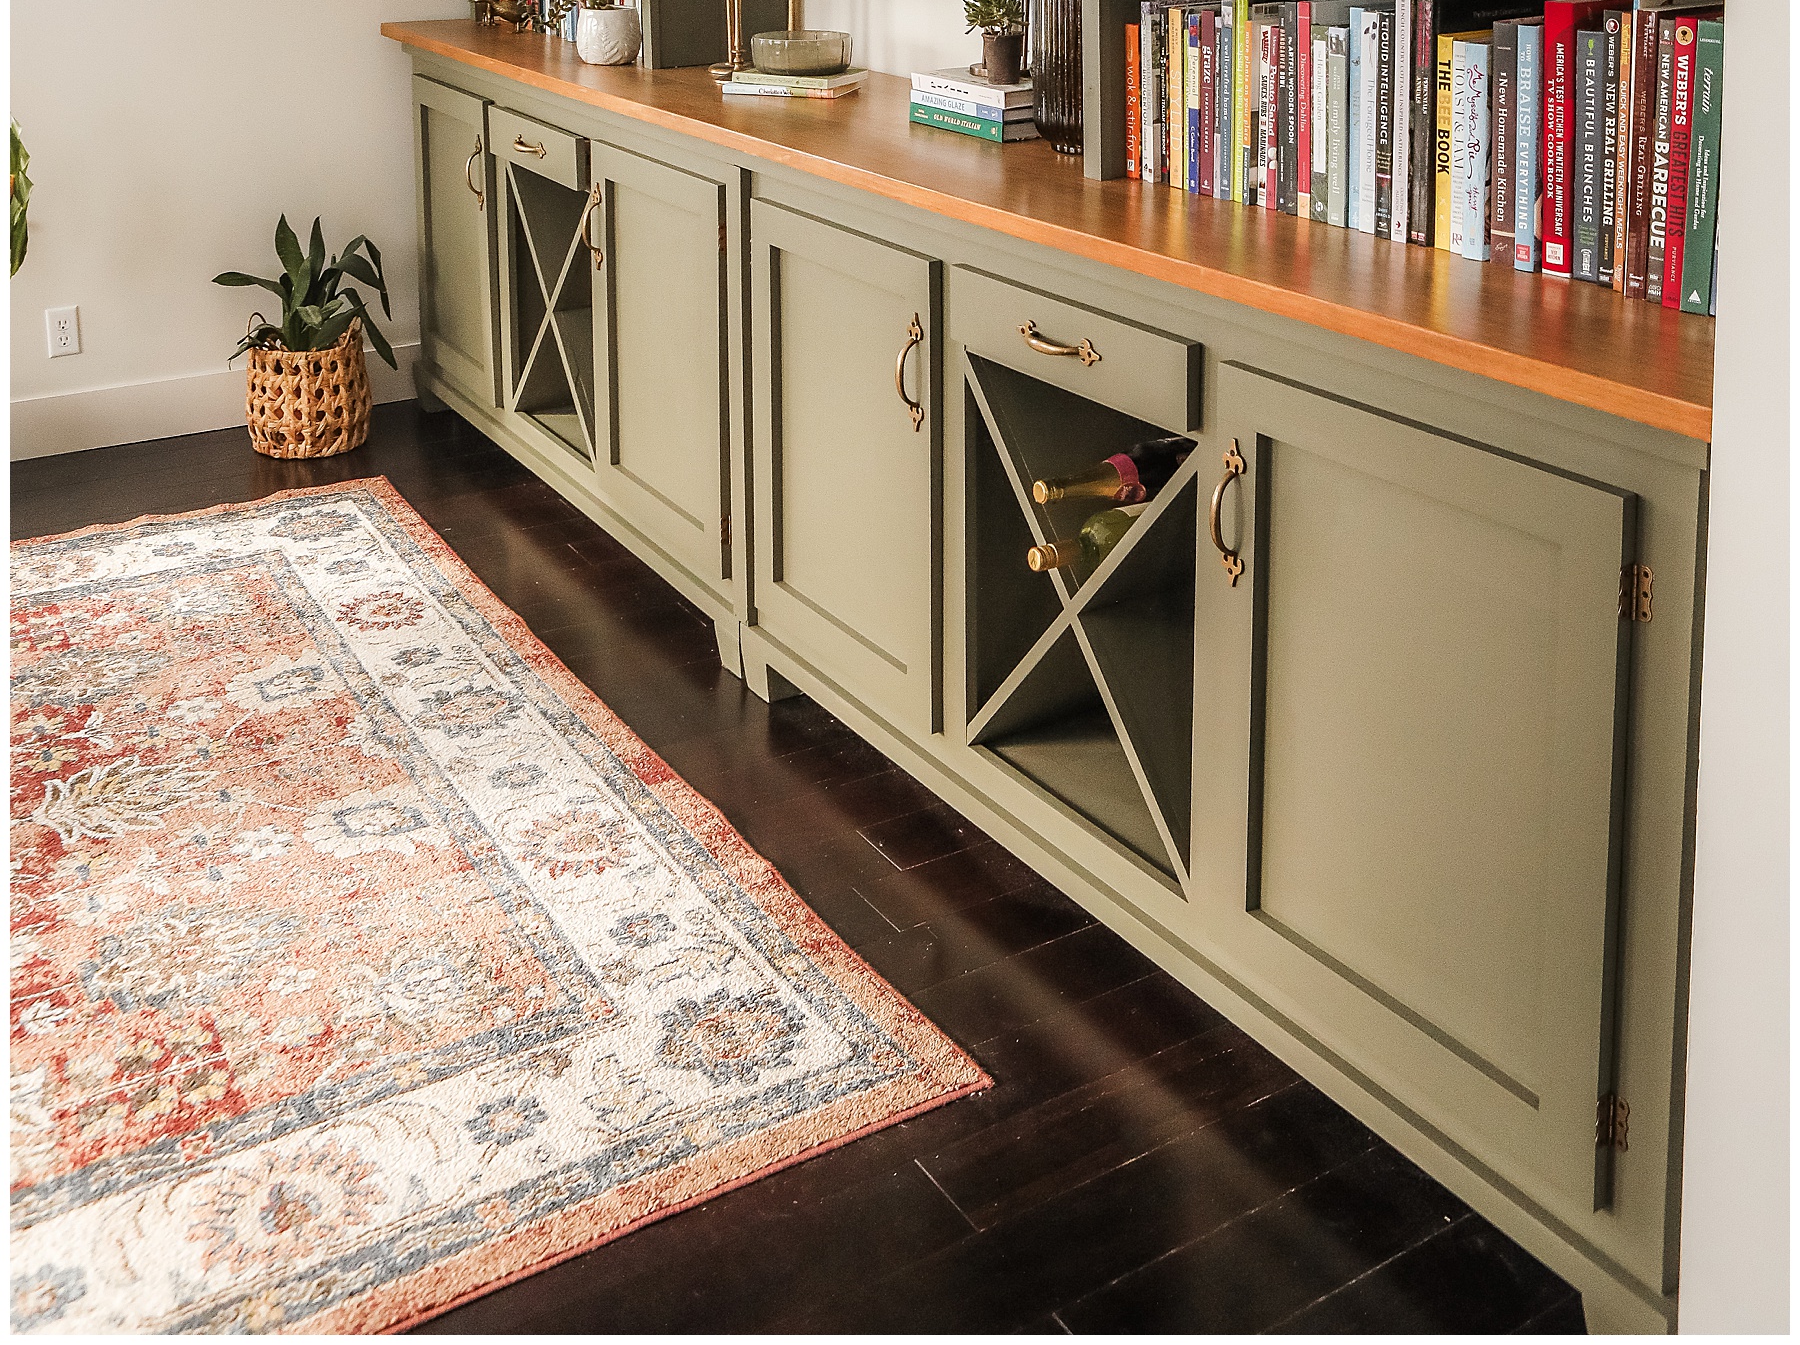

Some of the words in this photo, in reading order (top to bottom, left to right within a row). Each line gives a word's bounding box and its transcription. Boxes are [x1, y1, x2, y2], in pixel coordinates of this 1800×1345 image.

[1380, 21, 1390, 62] LIQUID
[1606, 36, 1615, 76] WEBER'S
[1126, 65, 1134, 91] wok
[1201, 46, 1211, 84] graze
[1269, 64, 1277, 101] Potato
[1439, 60, 1451, 92] THE
[1556, 42, 1565, 83] AMERICA'S
[1661, 54, 1669, 79] NEW
[921, 94, 947, 107] AMAZING
[947, 100, 965, 112] GLAZE
[1128, 94, 1136, 105] &
[1170, 69, 1180, 151] STYLED
[1379, 64, 1390, 146] INTELLIGENCE
[1439, 95, 1451, 125] BEE
[1454, 65, 1464, 118] TOAST
[1498, 78, 1508, 101] New
[1518, 66, 1532, 137] BRAISE
[1556, 85, 1564, 104] TEST
[1584, 59, 1596, 138] BEAUTIFUL
[1606, 83, 1616, 110] NEW
[1658, 80, 1669, 139] AMERICAN
[1674, 55, 1689, 125] WEBER'S
[1702, 67, 1713, 114] terrain
[960, 120, 981, 131] ITALIAN
[1127, 109, 1137, 153] stir-fry
[1268, 103, 1276, 137] Salad
[1330, 100, 1339, 135] simply
[1365, 99, 1374, 142] Foraged
[1454, 121, 1464, 133] &
[1555, 106, 1564, 138] KITCHEN
[1604, 117, 1615, 155] REAL
[1330, 139, 1339, 169] living
[1437, 131, 1450, 175] BOOK
[1454, 136, 1464, 170] JAM
[1498, 106, 1508, 174] Homemade
[1638, 136, 1647, 162] REAL
[1555, 140, 1564, 183] TWENTIETH
[1670, 130, 1688, 201] GREATEST
[1332, 173, 1340, 195] well
[1497, 175, 1507, 222] Kitchen
[1518, 142, 1529, 230] EVERYTHING
[1582, 143, 1594, 223] BRUNCHES
[1602, 156, 1615, 226] GRILLING
[1617, 161, 1625, 215] WEEKNIGHT
[1636, 165, 1646, 216] GRILLING
[1650, 141, 1669, 248] BARBECUE
[1554, 184, 1564, 237] ANNIVERSARY
[1669, 204, 1685, 237] HITS
